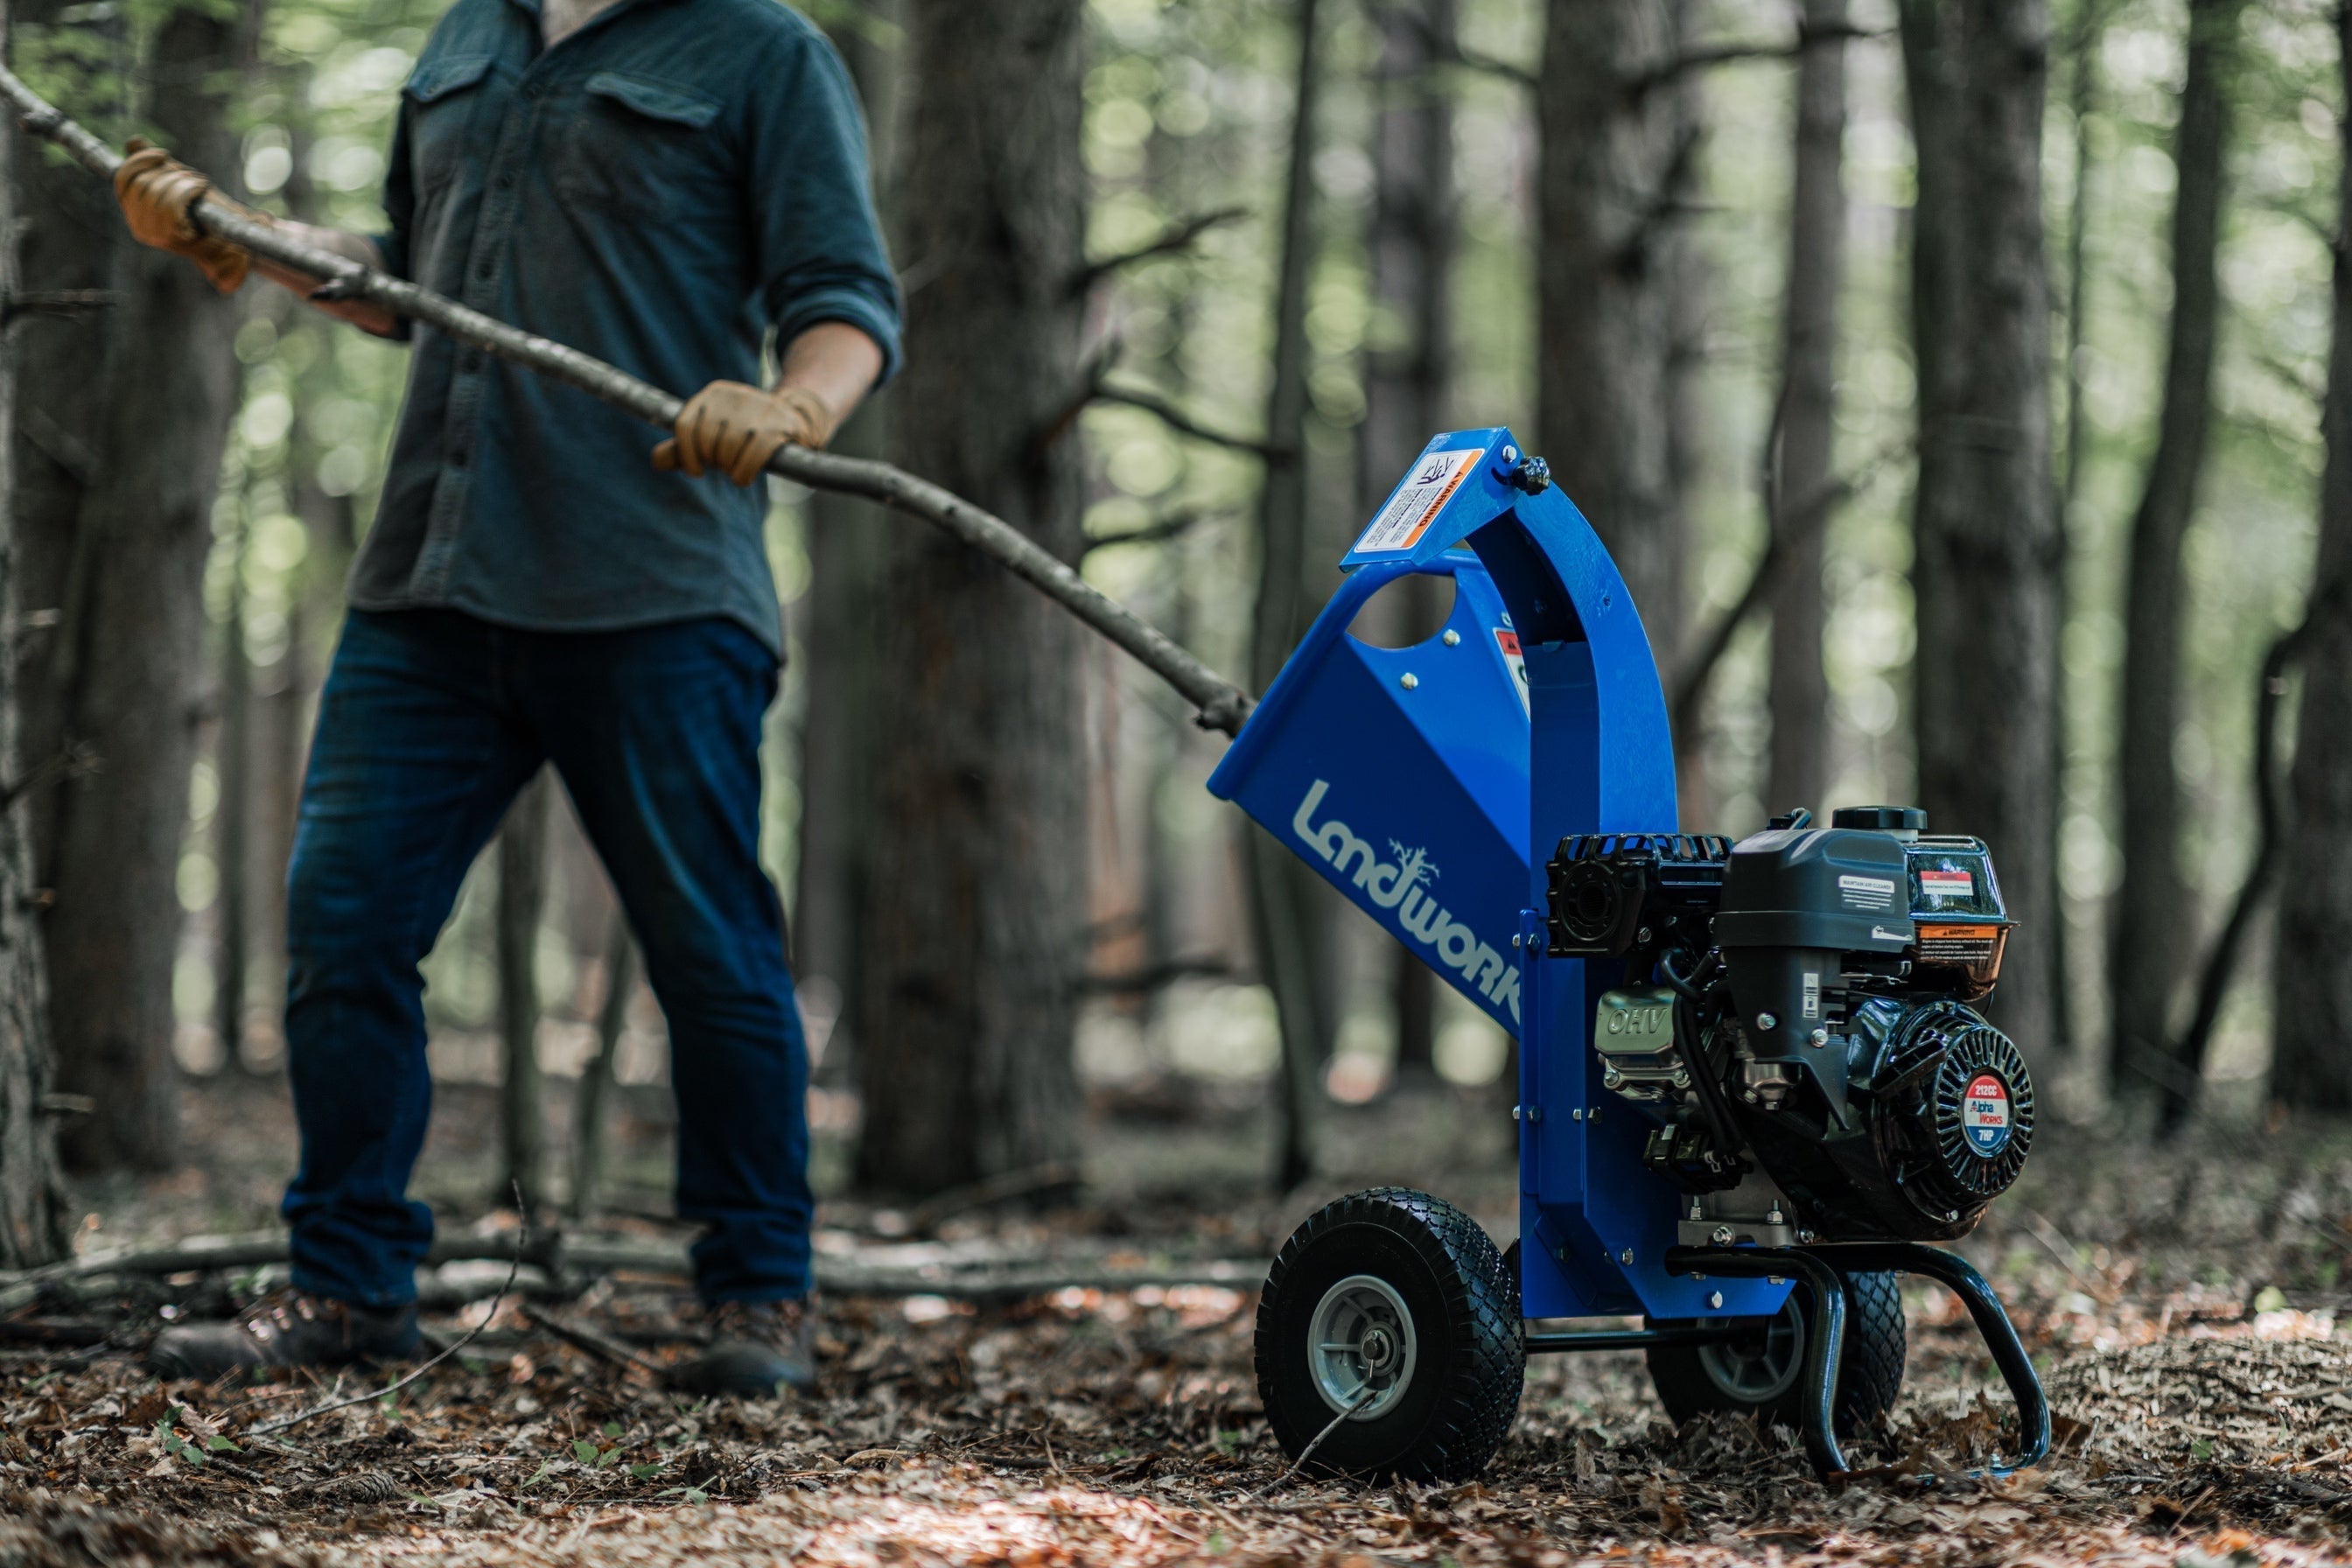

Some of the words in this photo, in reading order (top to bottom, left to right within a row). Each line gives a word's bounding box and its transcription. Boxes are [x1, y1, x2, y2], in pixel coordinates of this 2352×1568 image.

[1418, 480, 1457, 527] WARNING
[1607, 1008, 1668, 1034] OHV
[1975, 1084, 1998, 1096] 212CC
[1970, 1100, 1994, 1113] Alpha
[1978, 1129, 1994, 1142] 7HP
